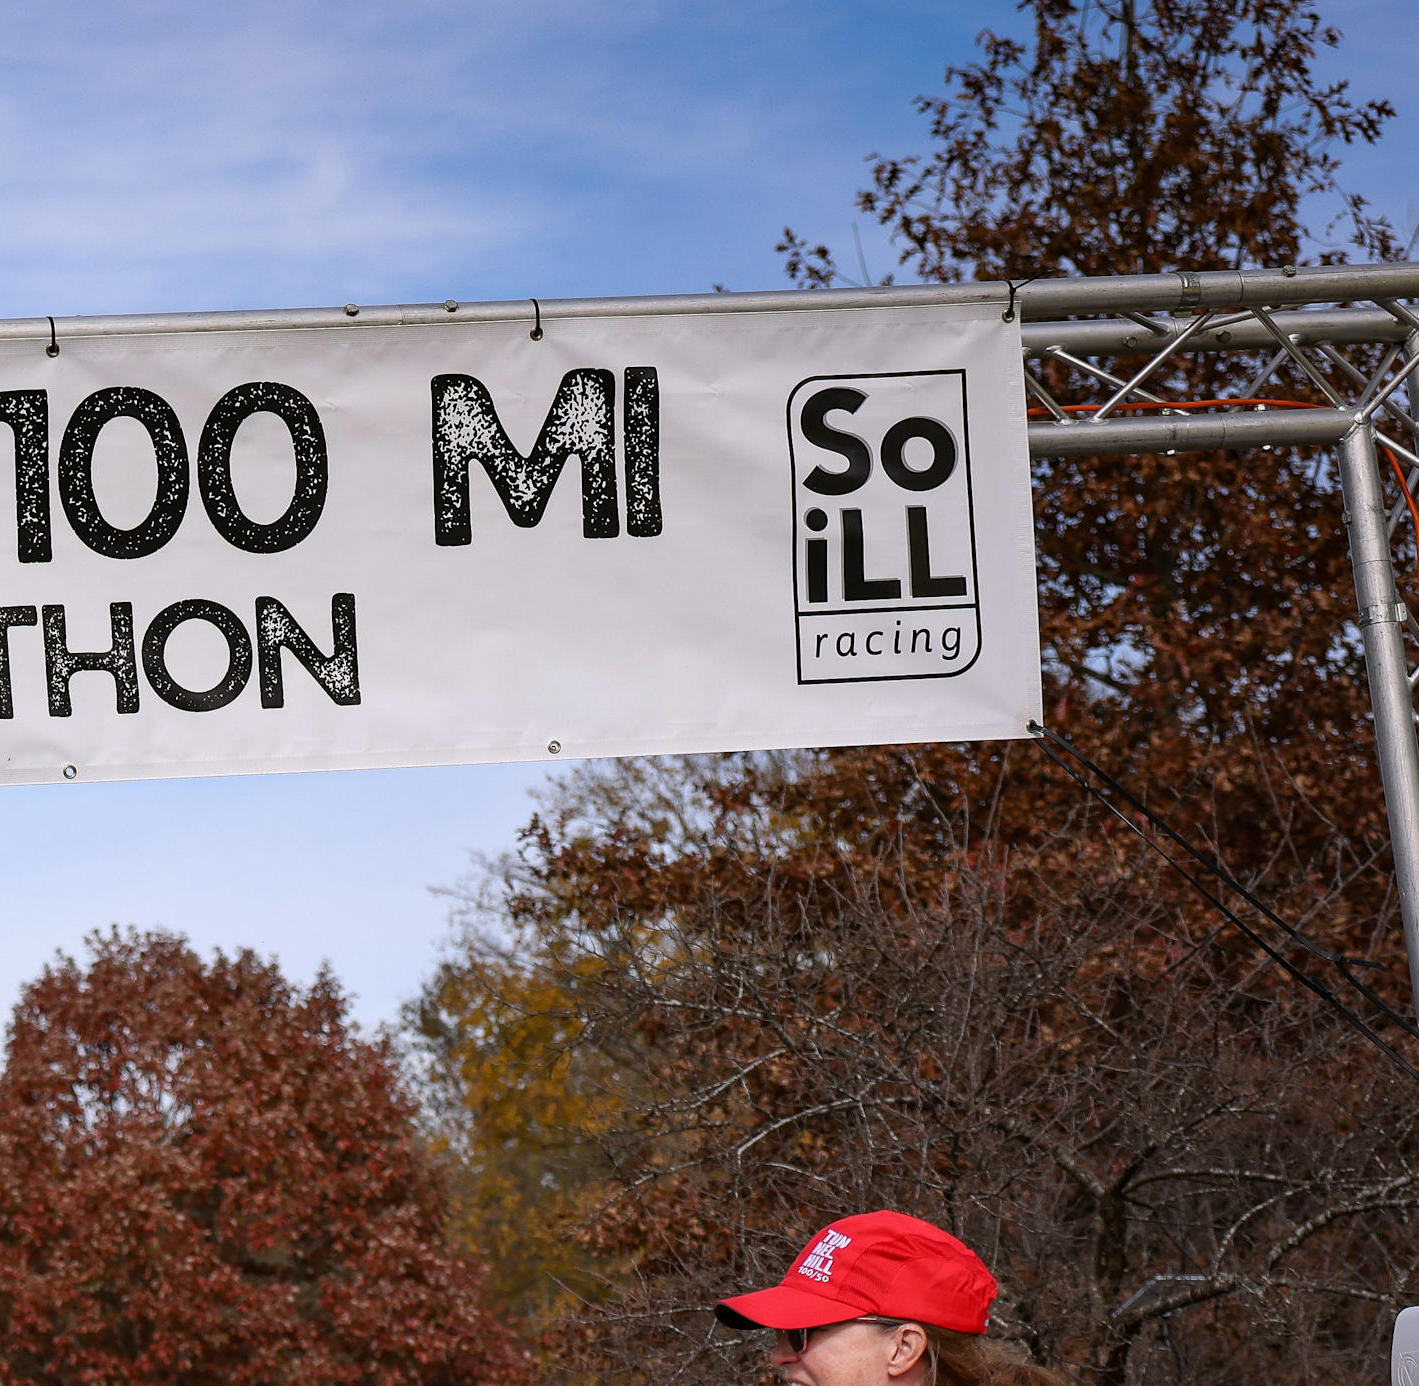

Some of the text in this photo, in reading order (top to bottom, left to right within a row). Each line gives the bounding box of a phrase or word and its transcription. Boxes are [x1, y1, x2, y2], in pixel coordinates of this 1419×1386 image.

[429, 366, 663, 547] MI
[800, 386, 959, 496] So
[803, 505, 968, 603] iLL
[814, 620, 962, 661] racing
[811, 1241, 836, 1260] NEL
[823, 1229, 852, 1249] TUN
[797, 1265, 830, 1283] 100/50
[802, 1253, 834, 1275] HILL
